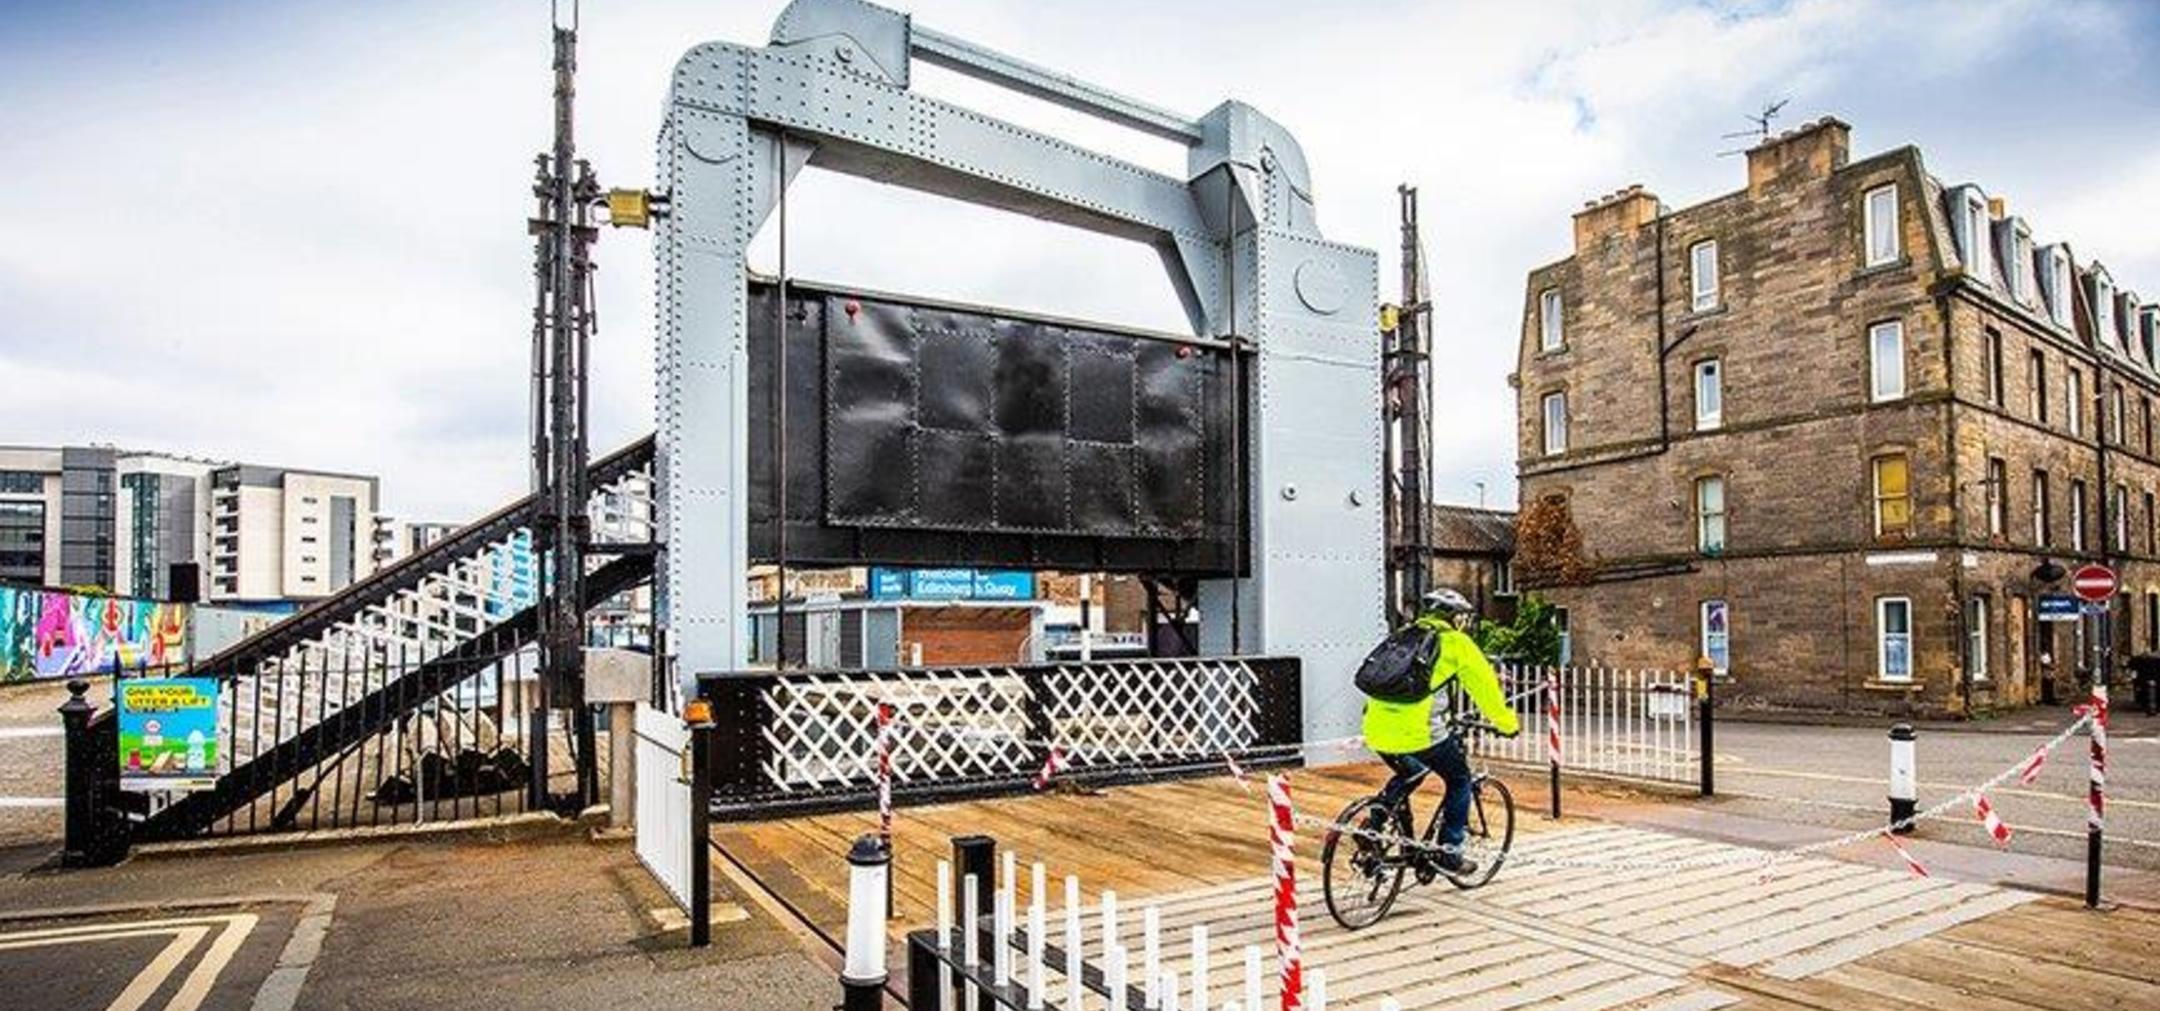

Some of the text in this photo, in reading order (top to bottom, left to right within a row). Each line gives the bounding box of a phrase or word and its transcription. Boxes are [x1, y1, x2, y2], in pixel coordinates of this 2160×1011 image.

[916, 581, 982, 597] Edinburgh
[984, 582, 1017, 597] Quay
[125, 687, 193, 696] GIVE YOUR
[126, 697, 169, 706] LITTER
